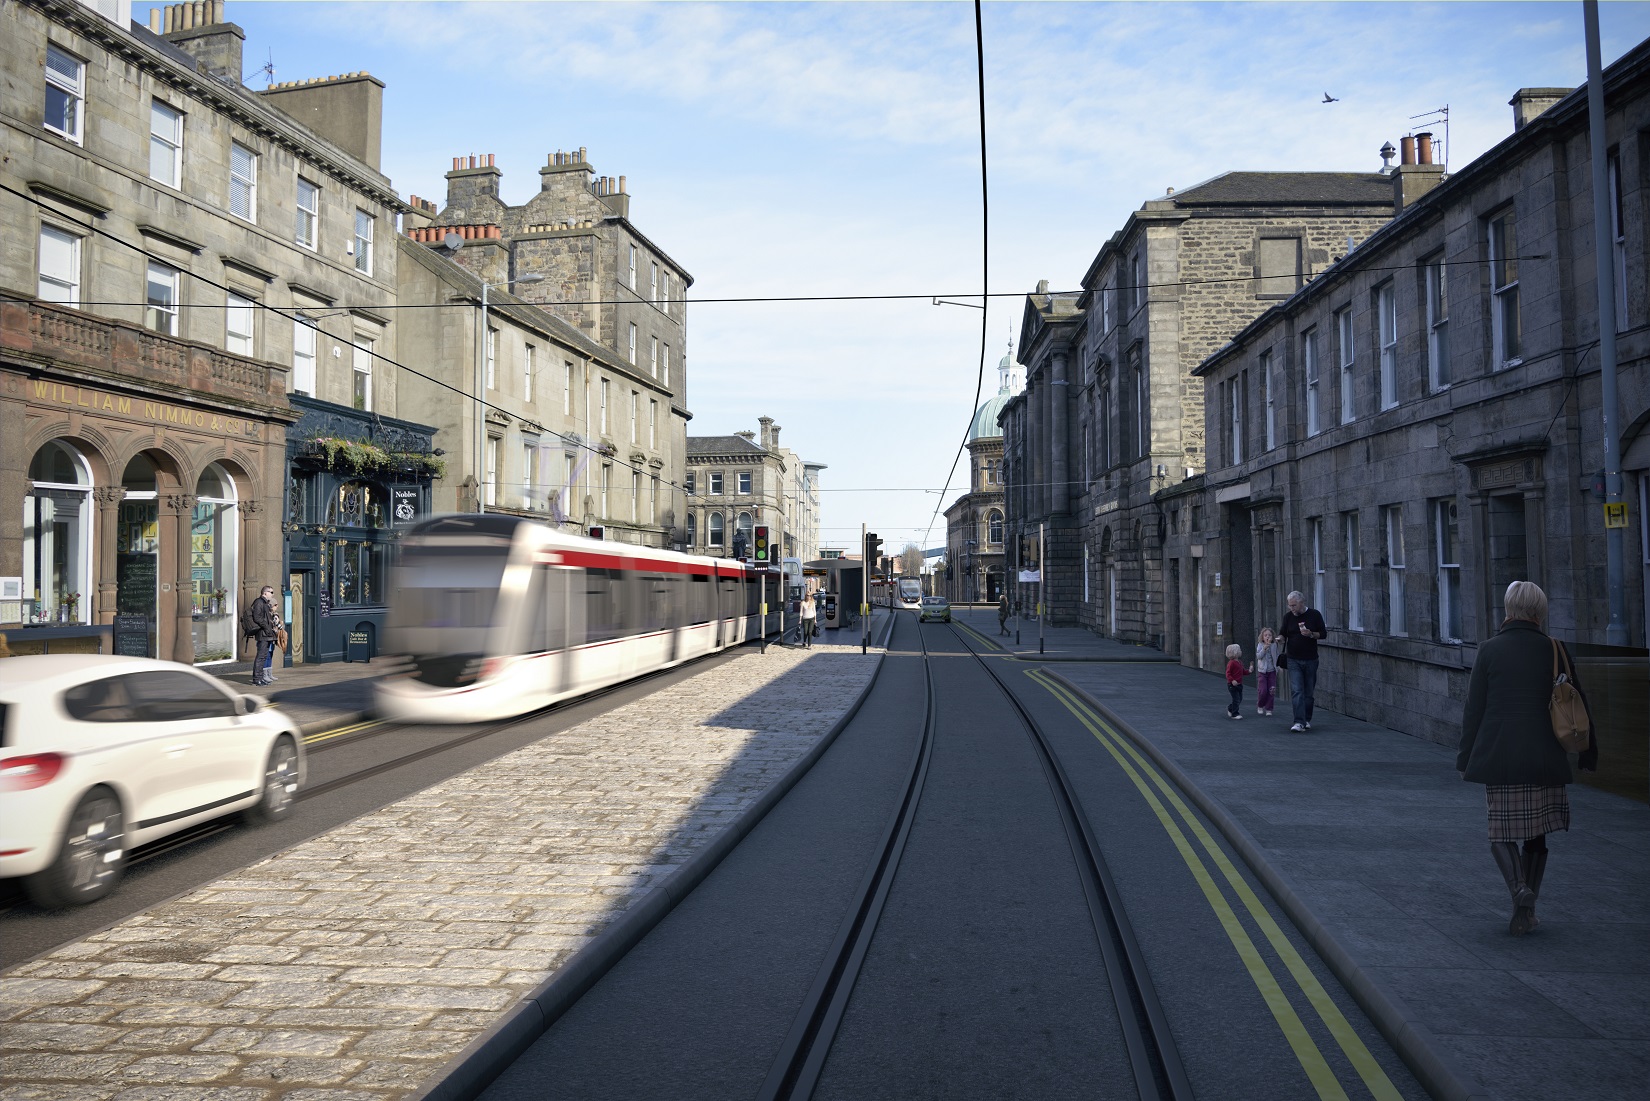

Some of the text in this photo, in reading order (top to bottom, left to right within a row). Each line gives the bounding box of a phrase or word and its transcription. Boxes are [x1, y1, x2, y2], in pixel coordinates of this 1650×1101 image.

[34, 380, 131, 415] WILLIAM
[145, 402, 205, 427] NIMMO
[210, 415, 219, 431] &
[395, 490, 417, 498] Nobles
